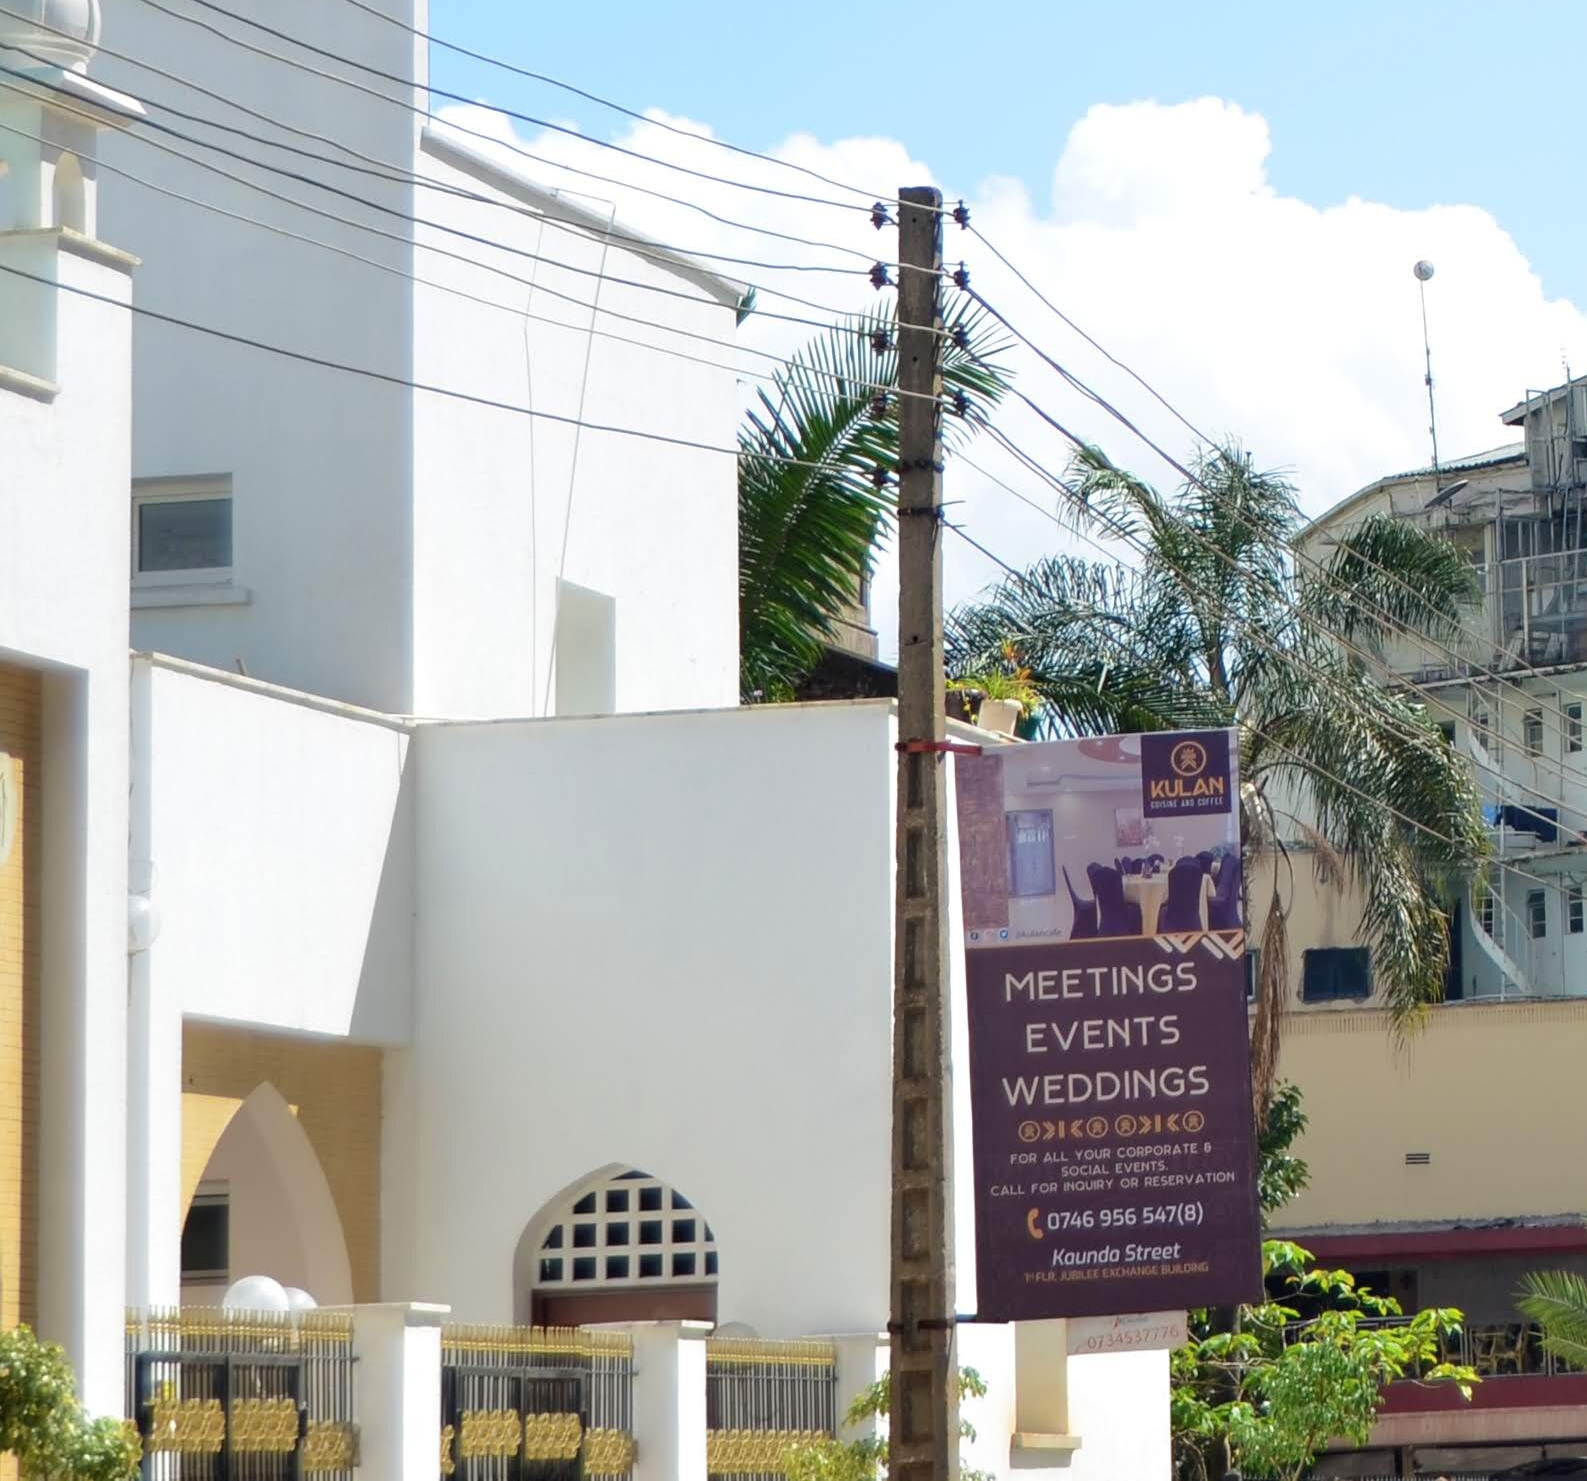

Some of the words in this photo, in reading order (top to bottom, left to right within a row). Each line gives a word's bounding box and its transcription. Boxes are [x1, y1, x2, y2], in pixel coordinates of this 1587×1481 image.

[1151, 776, 1224, 798] KULAN
[1181, 799, 1195, 807] AND
[1005, 962, 1197, 1002] MEETINGS
[1026, 1015, 1180, 1053] EVENTS
[1002, 1066, 1209, 1106] WEDDINGS
[1010, 1153, 1037, 1165] FOR
[1043, 1151, 1068, 1163] ALL
[1075, 1148, 1111, 1161] YOUR
[1117, 1143, 1198, 1158] CORPORATE
[1061, 1163, 1109, 1177] SOCIAL
[1115, 1160, 1169, 1174] EVENTS.
[990, 1184, 1025, 1196] CALL
[1031, 1182, 1058, 1194] FOR
[1063, 1179, 1113, 1192] INQUIRY
[1120, 1177, 1140, 1189] OR
[1144, 1171, 1235, 1187] RESERVATION
[1048, 1211, 1094, 1230] 0746
[1100, 1208, 1137, 1226] 956
[1142, 1201, 1204, 1225] 547(8)
[1052, 1245, 1120, 1267] Kaunda
[1125, 1242, 1181, 1262] Street
[1060, 1268, 1099, 1281] JUBILEE
[1102, 1265, 1159, 1279] EXCHANGE
[1161, 1262, 1209, 1276] BUILDING
